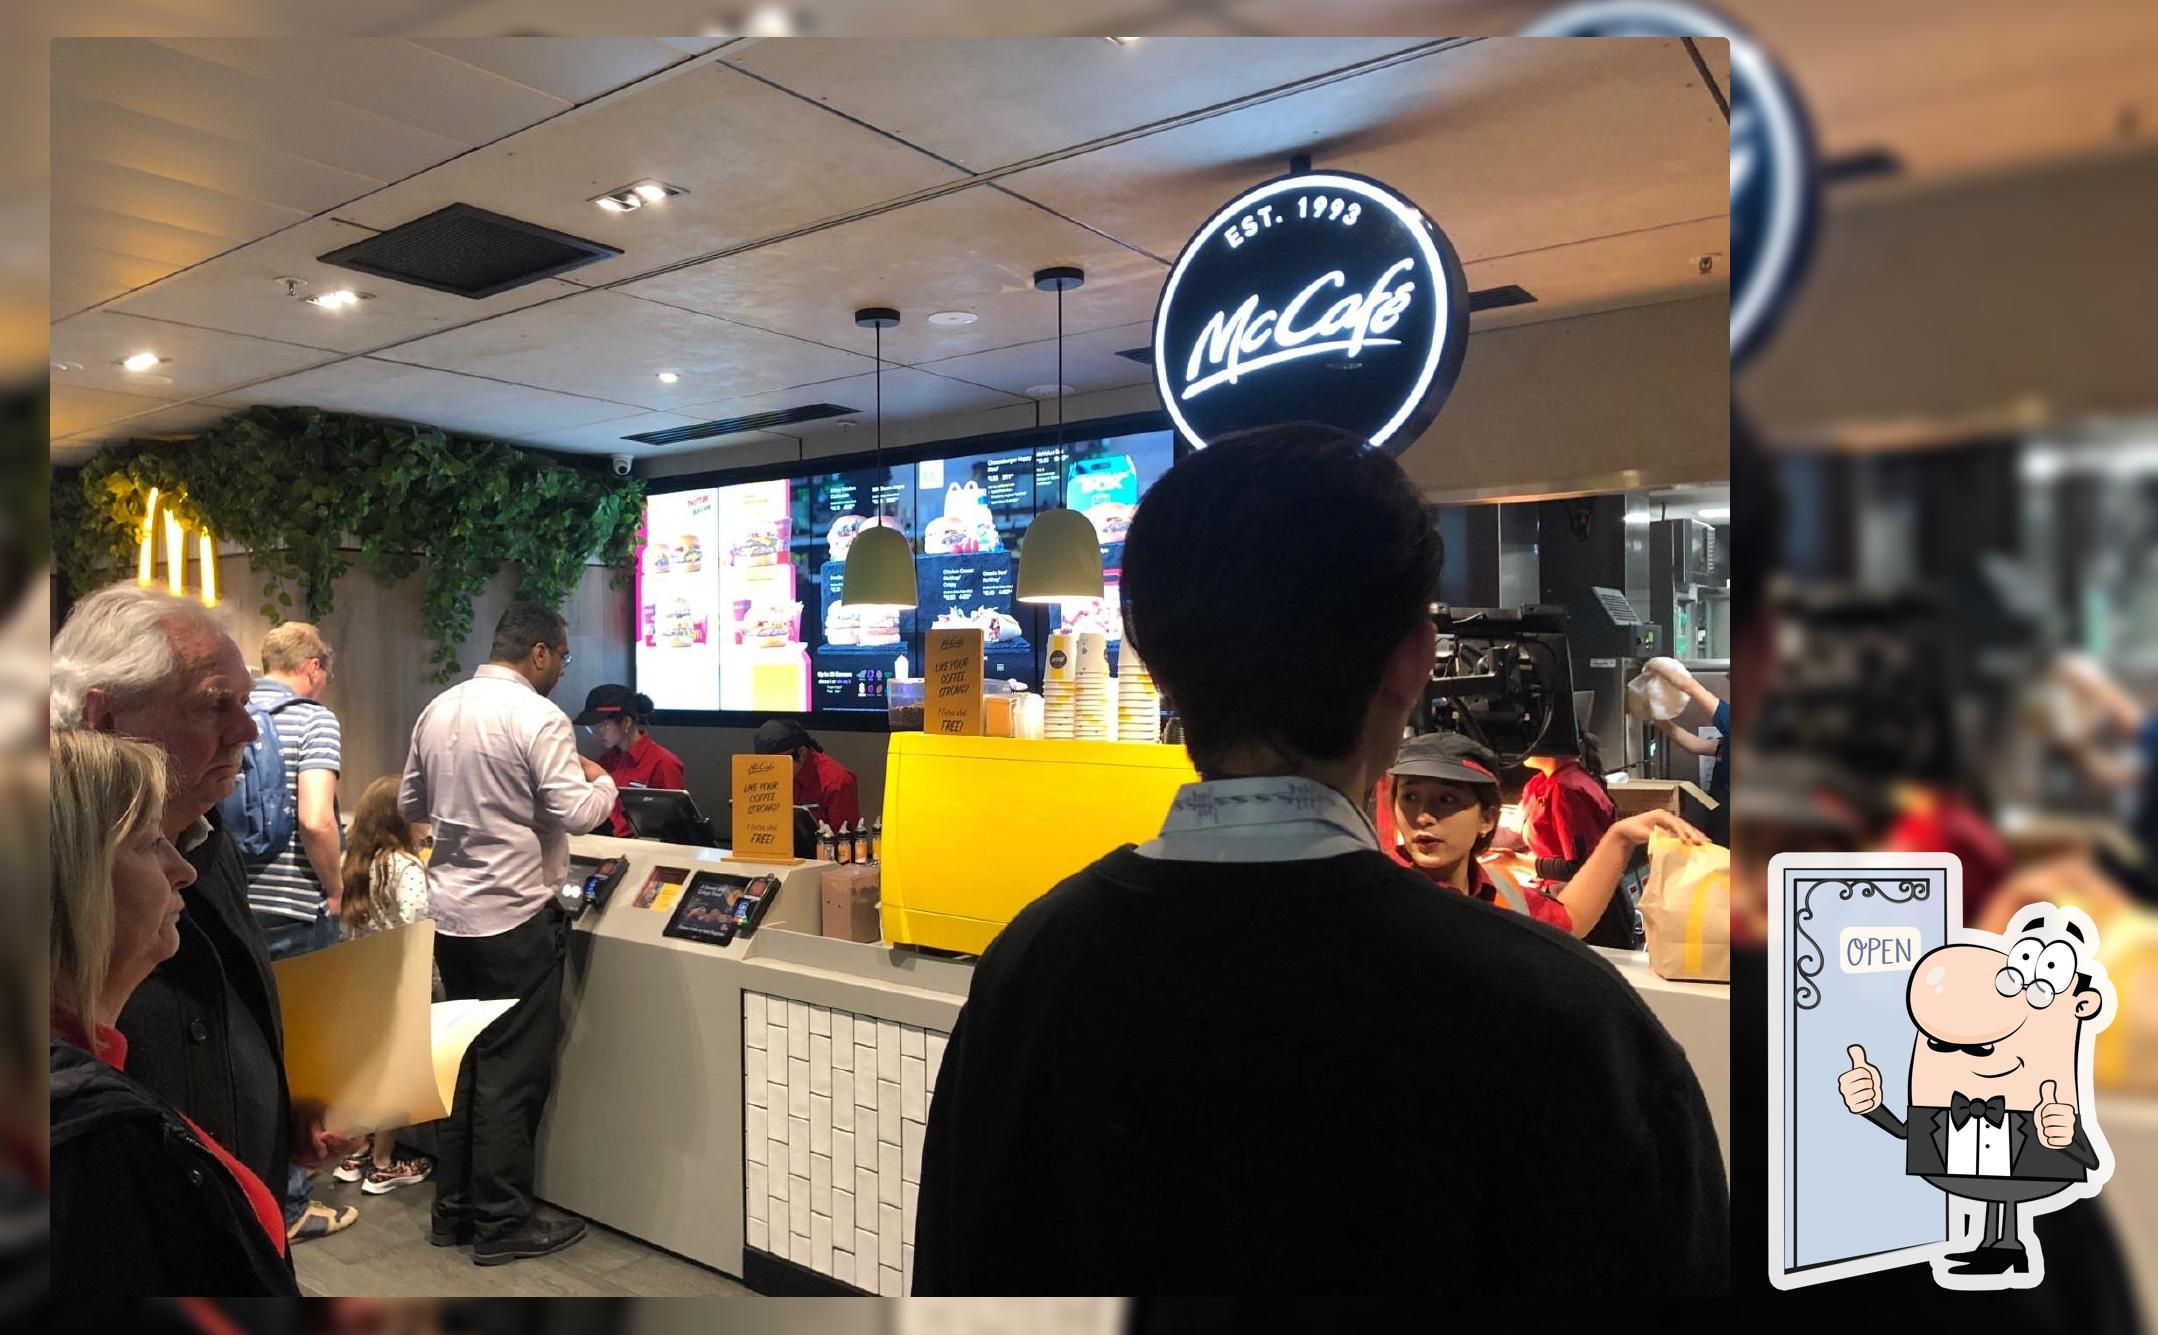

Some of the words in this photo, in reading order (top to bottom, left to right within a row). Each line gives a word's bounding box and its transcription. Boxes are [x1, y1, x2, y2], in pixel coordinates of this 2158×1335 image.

[1223, 204, 1283, 249] EST.
[1297, 195, 1362, 226] 1993
[1182, 257, 1415, 399] McCafé
[935, 660, 948, 673] LIKE
[949, 657, 969, 671] YOUR
[940, 671, 966, 685] COFFEE
[938, 684, 970, 698] STRONG?
[759, 781, 779, 792] YOUR
[749, 792, 776, 804] COFFEE
[750, 833, 776, 845] FREE!
